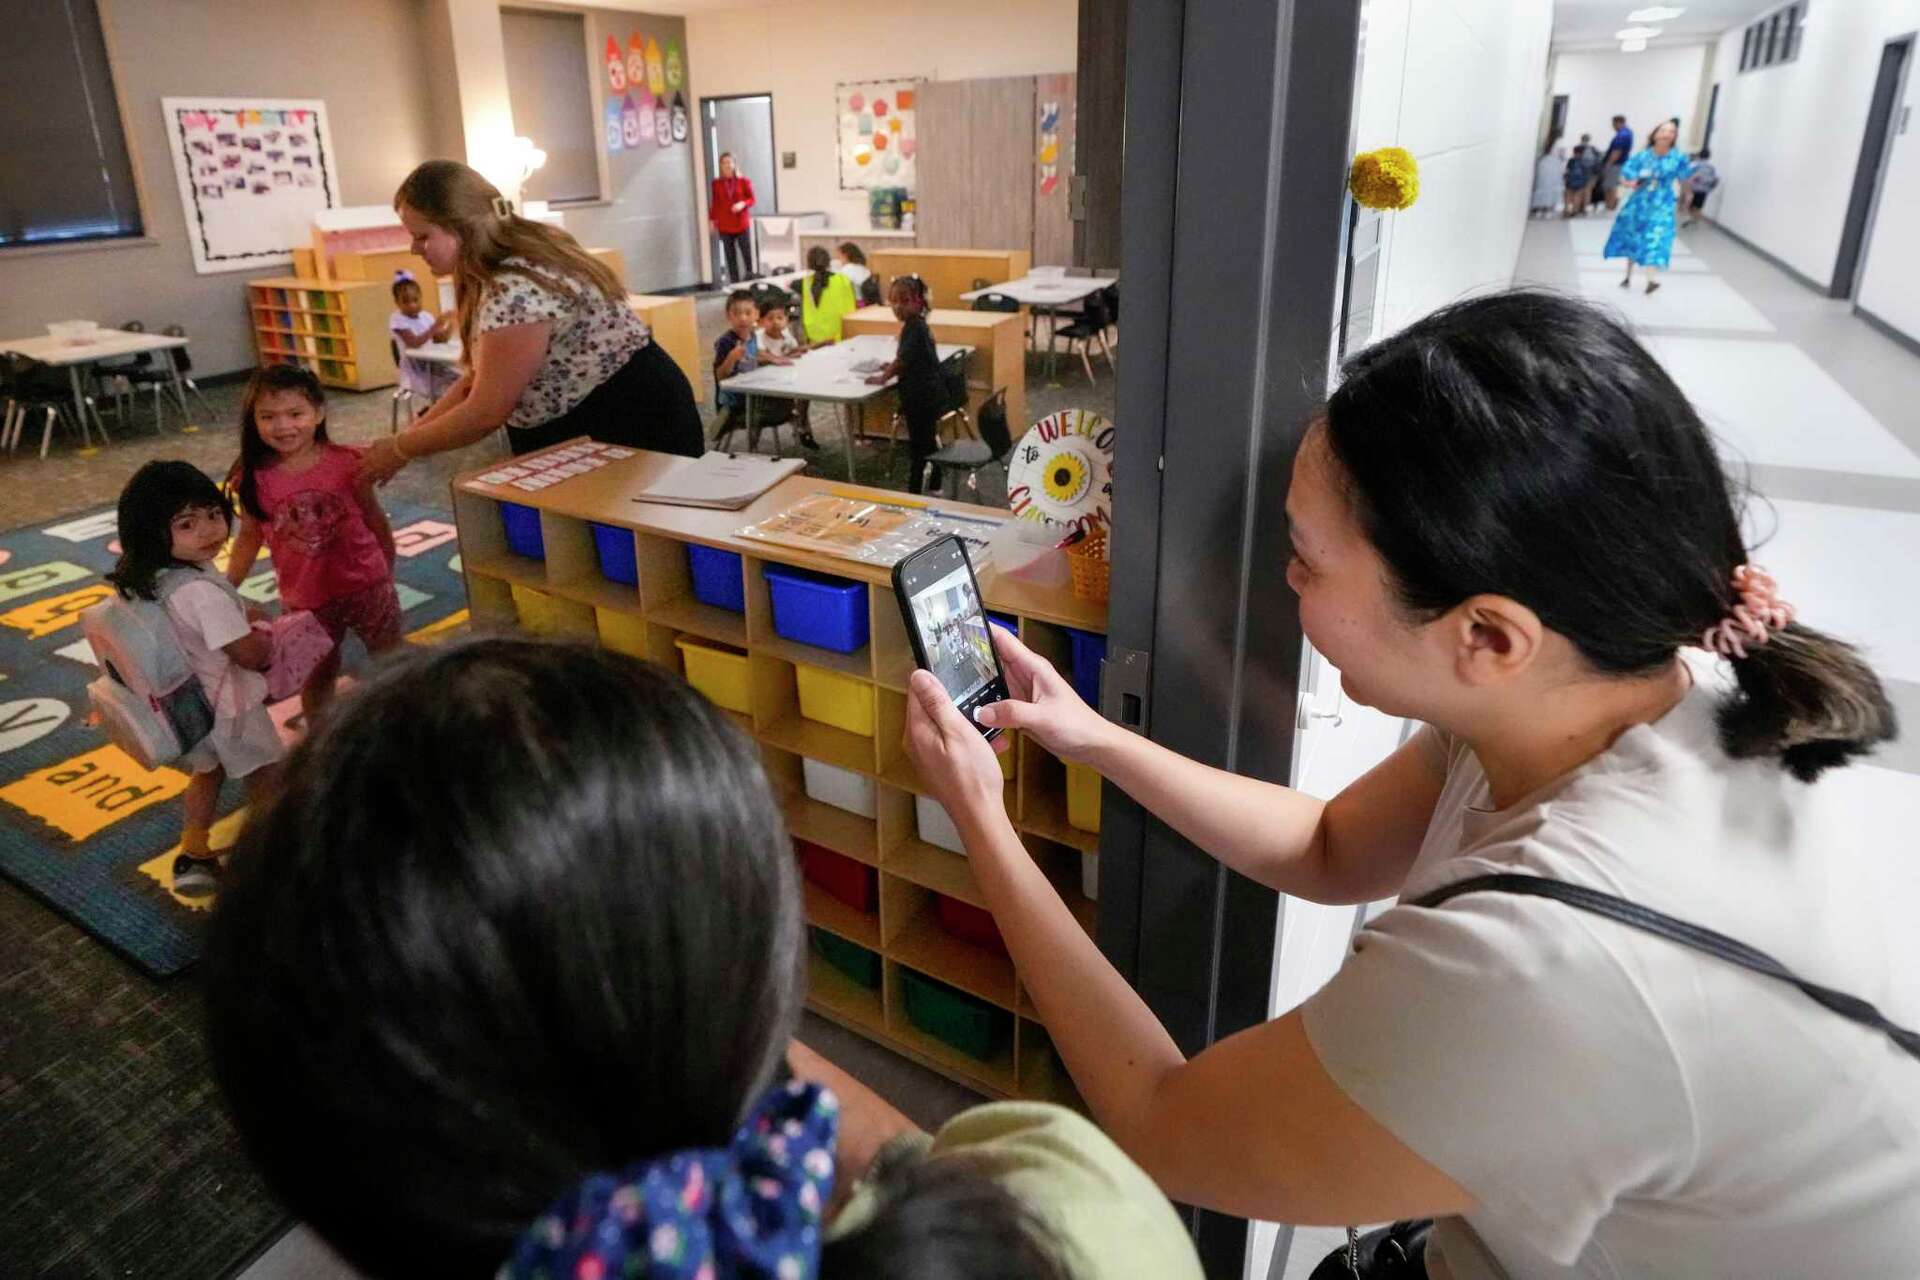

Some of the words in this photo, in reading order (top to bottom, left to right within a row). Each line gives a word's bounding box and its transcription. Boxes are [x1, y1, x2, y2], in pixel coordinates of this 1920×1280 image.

[1021, 445, 1040, 464] to
[1036, 409, 1115, 474] WELCO
[45, 761, 164, 812] and
